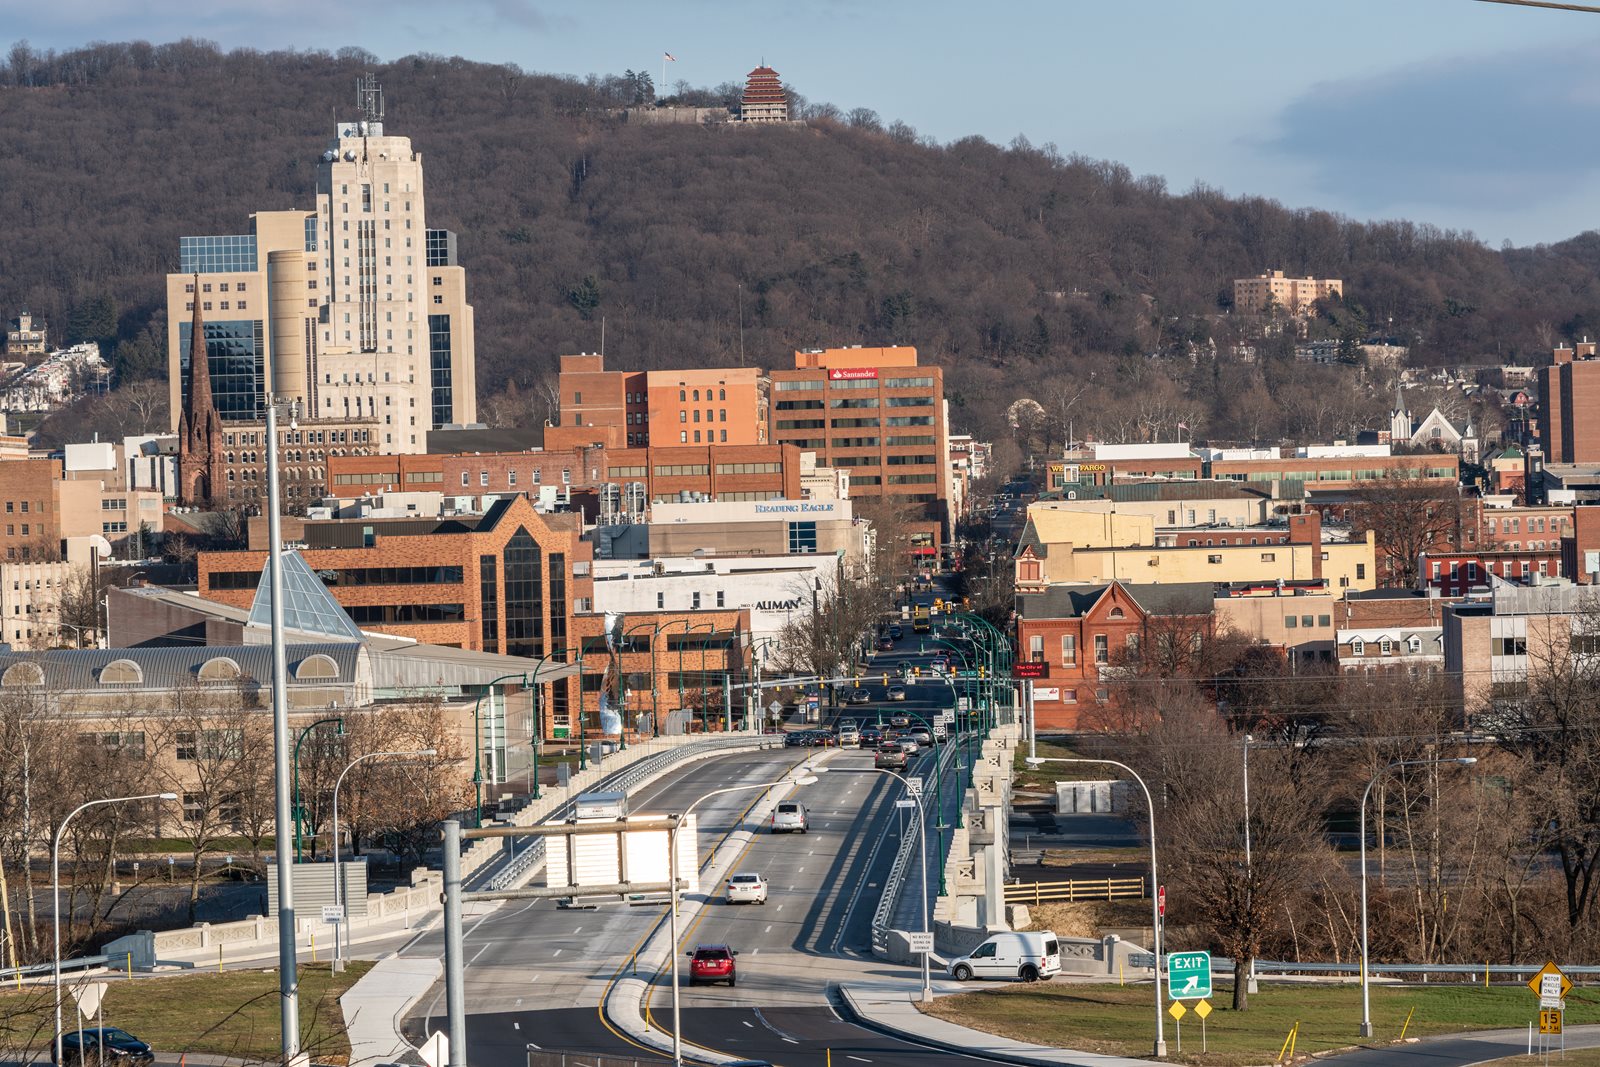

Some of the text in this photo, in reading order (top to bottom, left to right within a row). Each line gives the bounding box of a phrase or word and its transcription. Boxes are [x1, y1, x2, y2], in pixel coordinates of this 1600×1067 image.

[842, 370, 875, 378] Santander
[1079, 464, 1106, 472] FARGO
[755, 503, 834, 513] READING EAGLE
[1175, 957, 1202, 968] EXIT
[1544, 1014, 1558, 1024] 15
